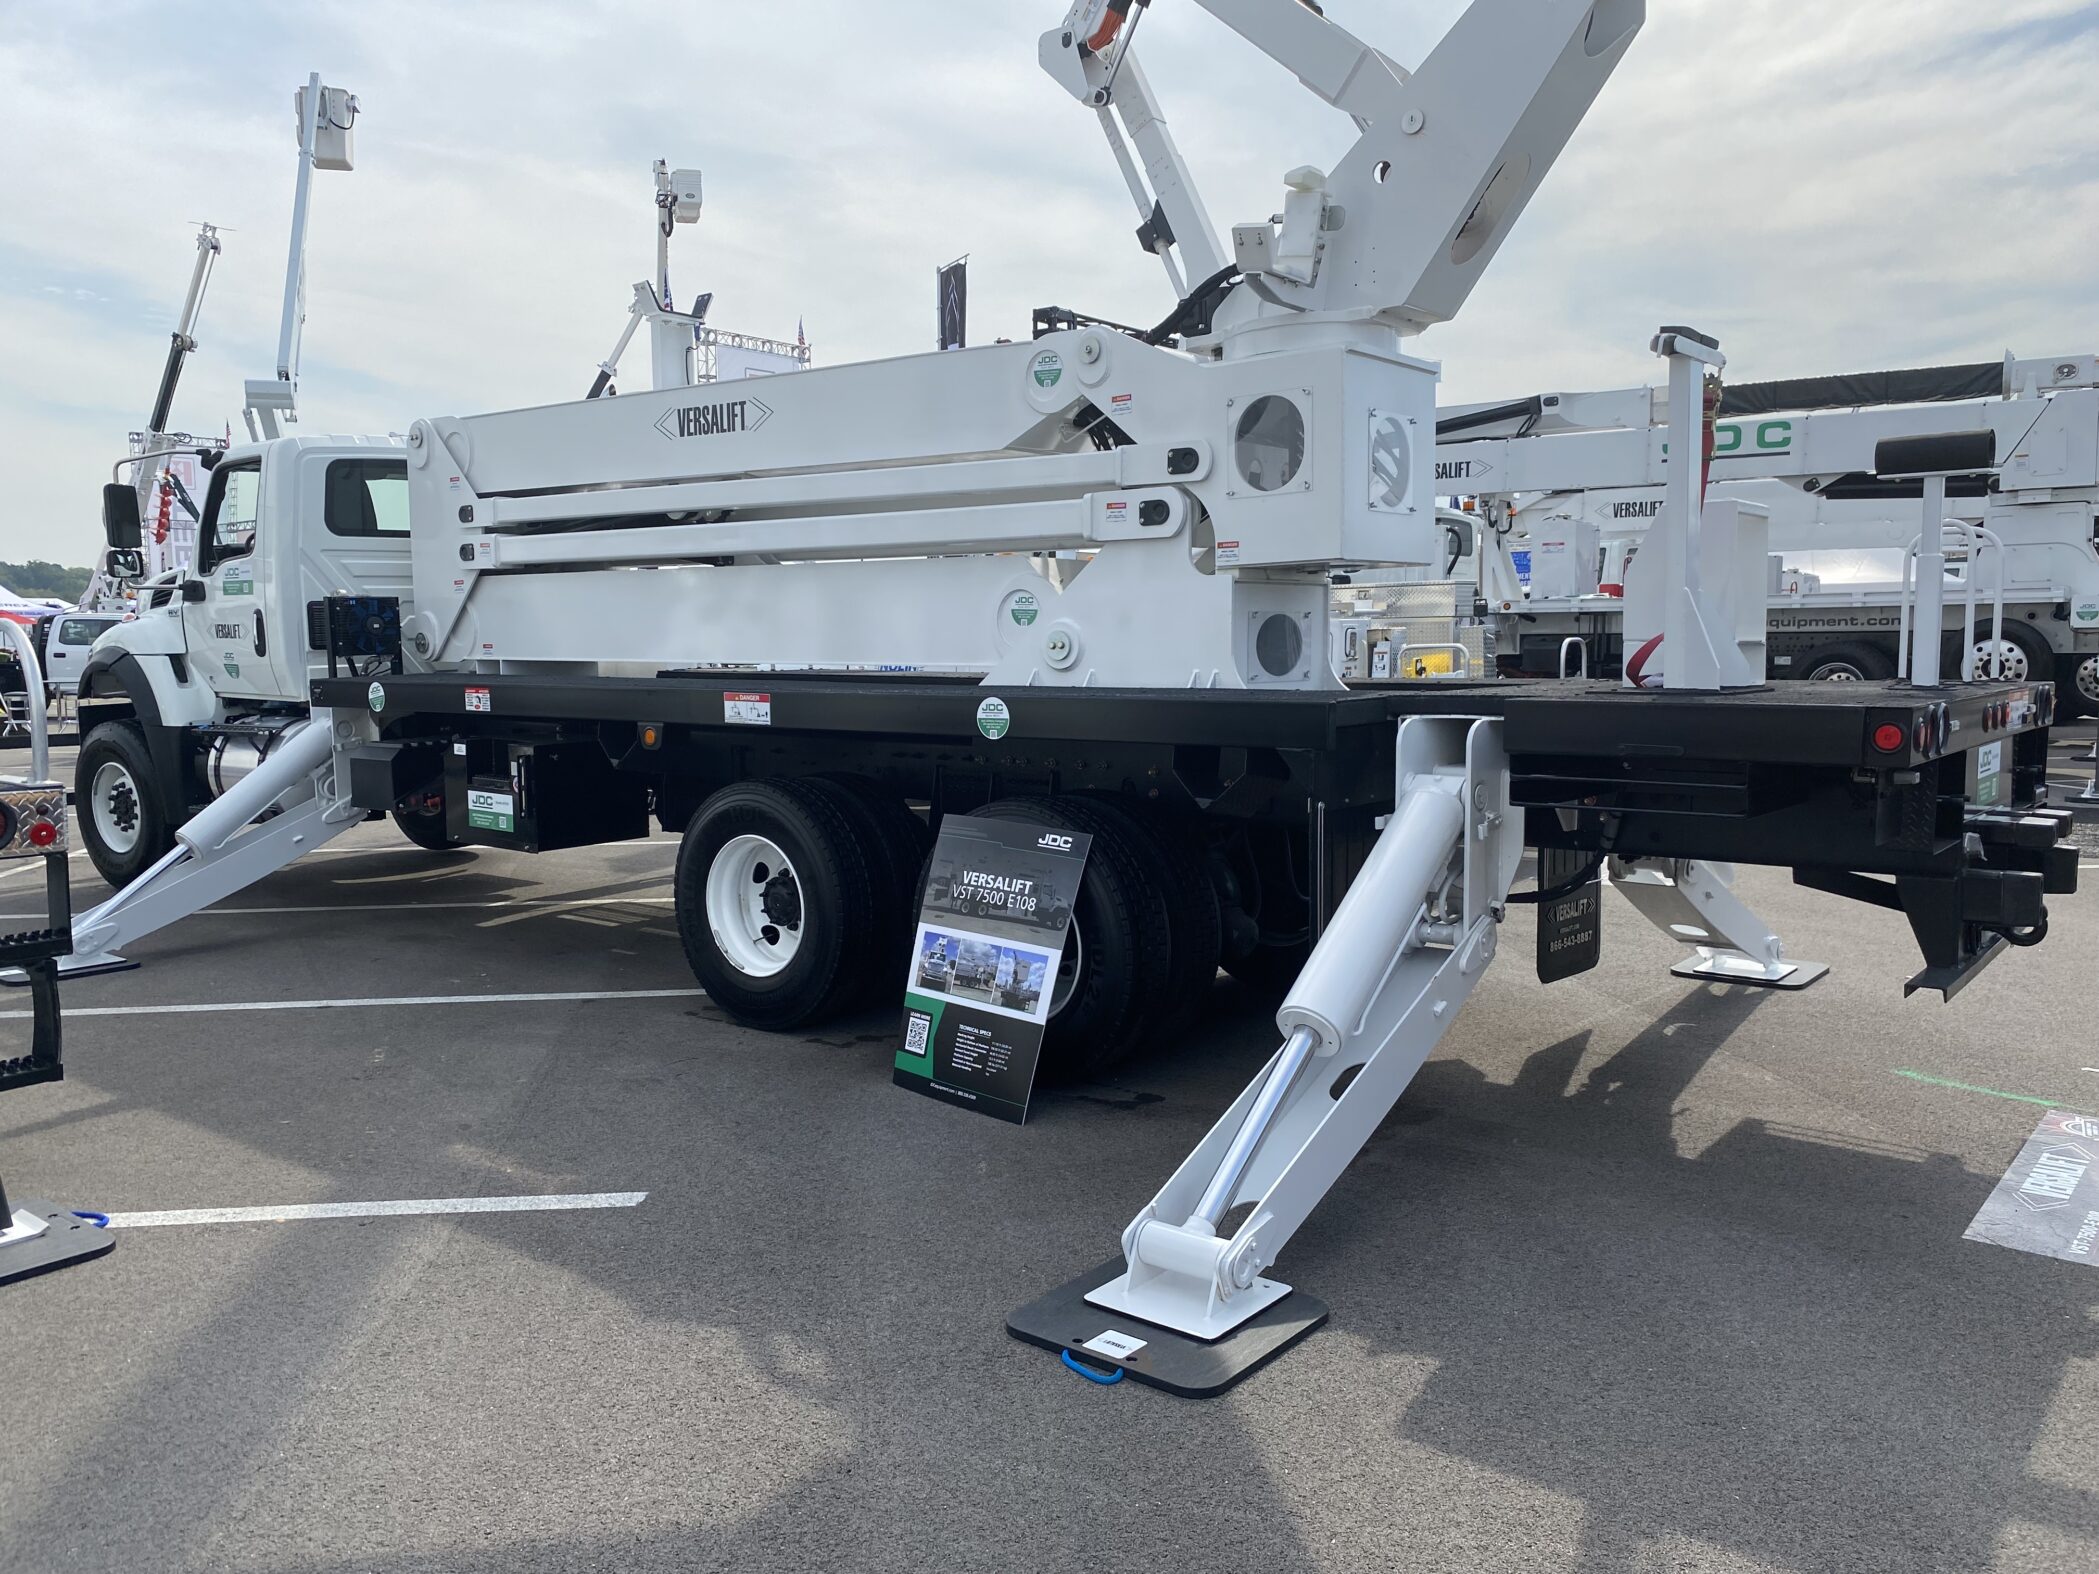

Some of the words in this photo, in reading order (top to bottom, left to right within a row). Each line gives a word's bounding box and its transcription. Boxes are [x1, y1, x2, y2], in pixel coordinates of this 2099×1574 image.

[1038, 355, 1058, 364] JDC
[677, 400, 747, 438] VERSALIFT
[1014, 596, 1034, 604] JDC
[214, 623, 241, 639] VERSALIFT
[981, 703, 1004, 712] JDC
[472, 794, 494, 807] JDC
[1038, 833, 1073, 849] JDC
[963, 870, 1033, 895] VERSALIFT
[952, 883, 974, 900] VST
[976, 887, 1005, 906] 7500
[1007, 893, 1037, 911] E108
[1555, 898, 1588, 923] VERSALIFT
